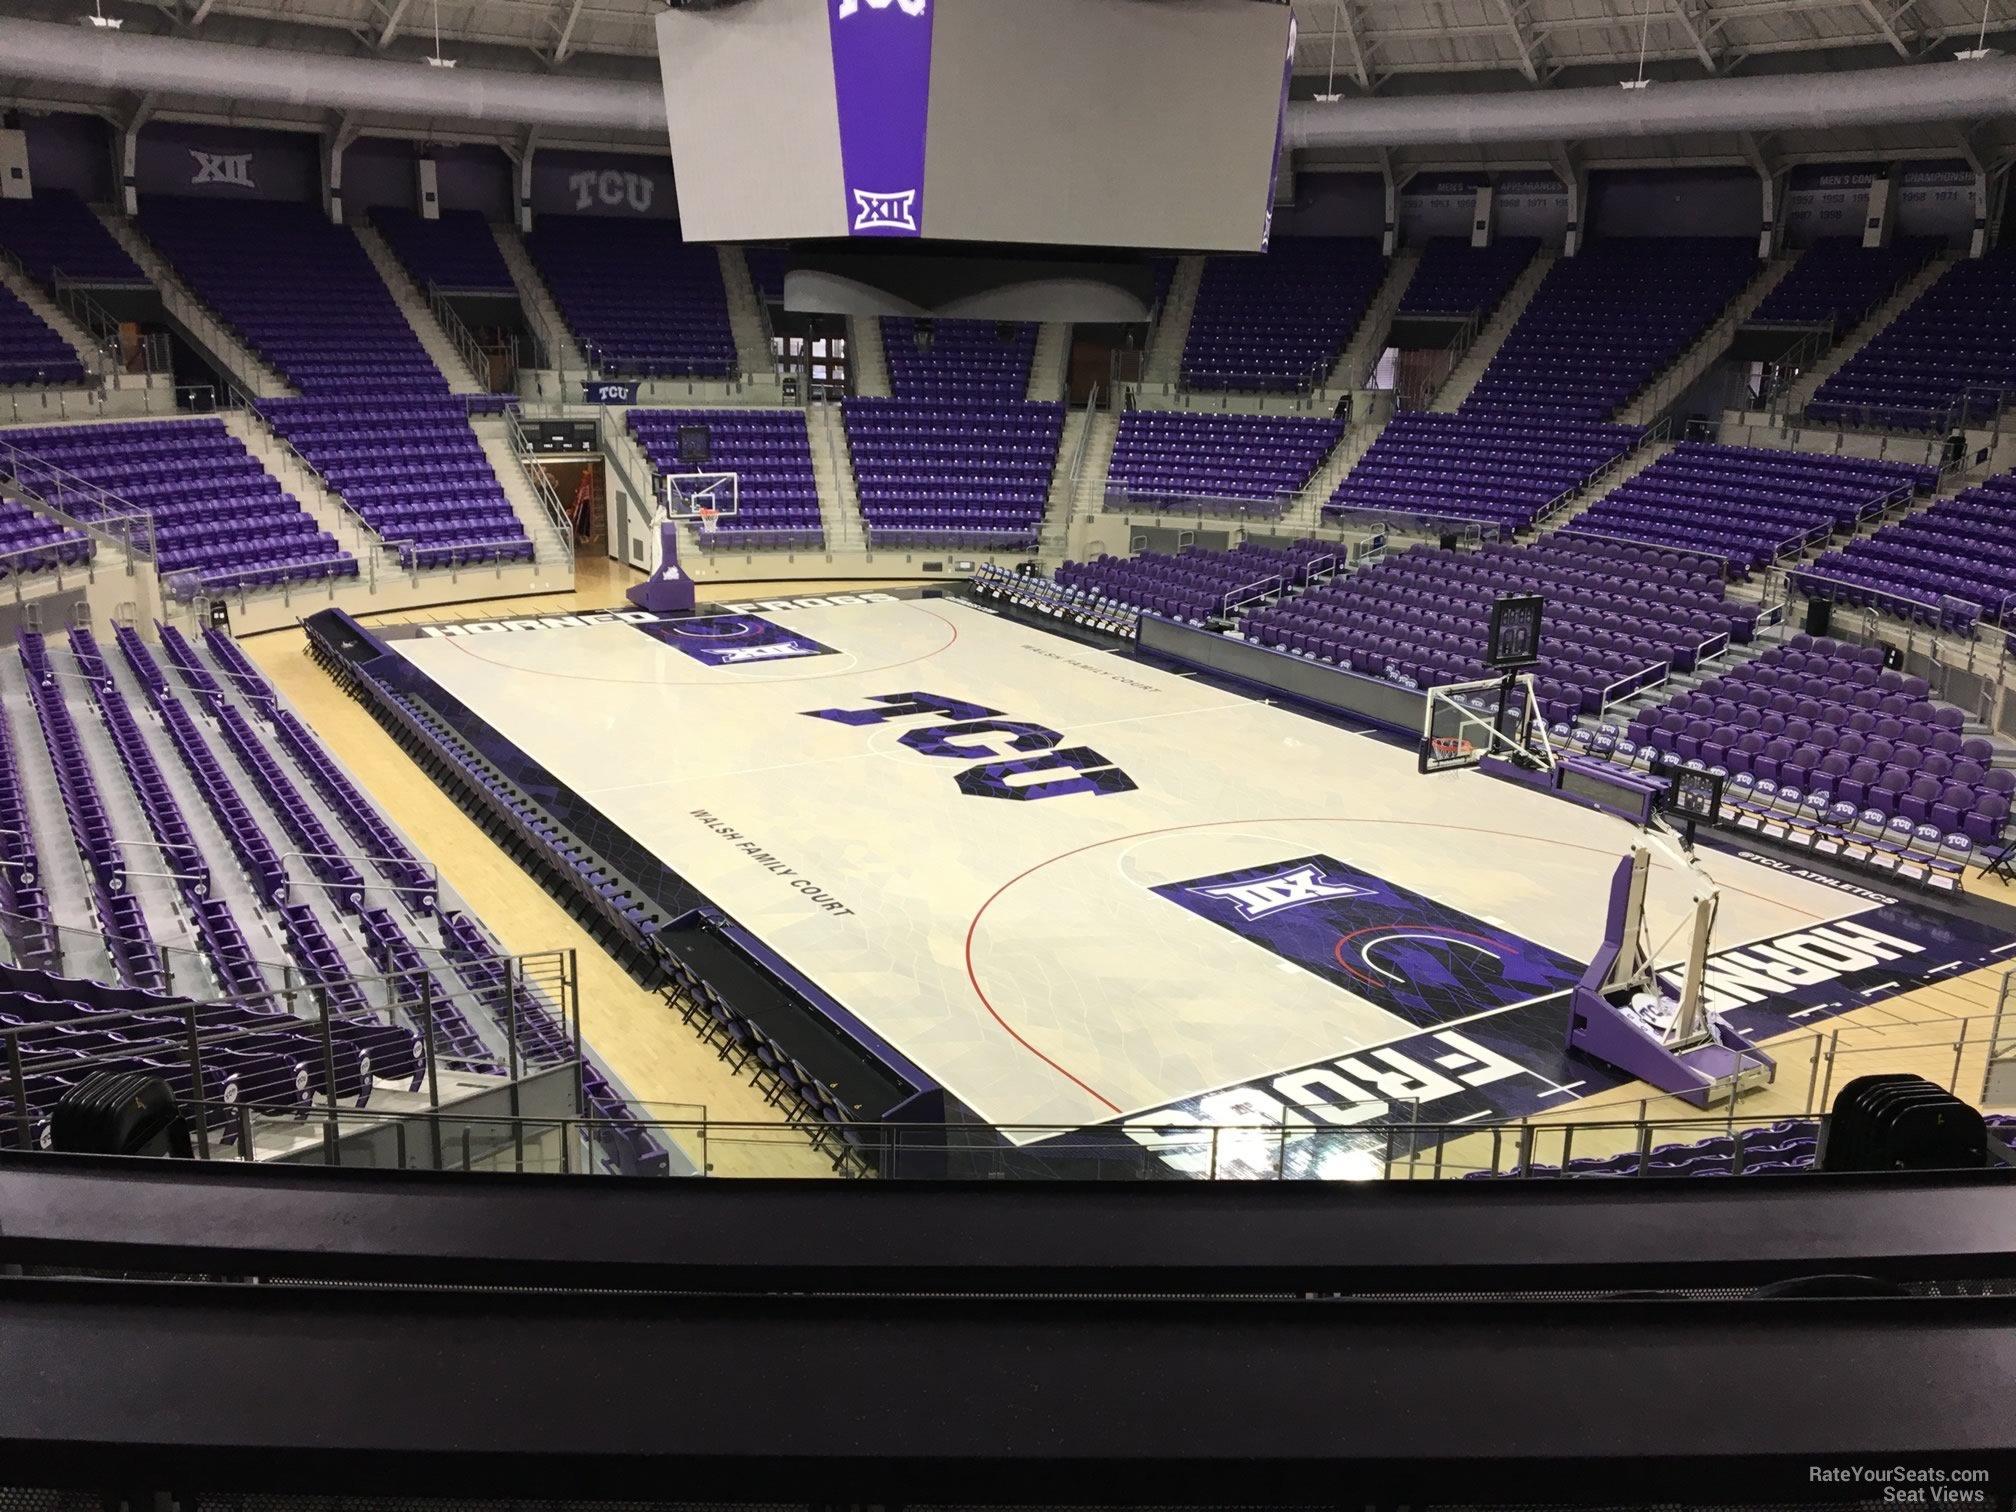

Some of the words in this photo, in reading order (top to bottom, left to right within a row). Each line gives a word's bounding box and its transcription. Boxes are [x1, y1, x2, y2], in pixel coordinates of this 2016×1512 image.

[191, 149, 255, 188] XII
[569, 169, 654, 212] TCU
[857, 191, 913, 227] XII
[599, 386, 628, 400] TCU
[421, 611, 660, 638] HORNED
[726, 592, 902, 615] FROGS
[1601, 725, 1615, 734] TCU
[796, 691, 1139, 801] TCU
[1597, 736, 1611, 746] TCU
[1619, 742, 1634, 752] TCU
[1663, 754, 1680, 764] TCU
[1735, 774, 1753, 786] TCU
[1758, 780, 1775, 791] TCU
[1781, 788, 1799, 800] TCU
[1807, 795, 1825, 807] TCU
[1836, 803, 1854, 815] TCU
[1864, 811, 1883, 823] TCU
[1892, 818, 1912, 831] TCU
[1918, 826, 1938, 839] TCU
[1948, 834, 1969, 847] TCU
[689, 809, 744, 841] WALSH
[735, 841, 799, 876] FAMILY
[790, 879, 856, 917] COURT
[1738, 851, 1899, 905] @TCU_ATHLETICS
